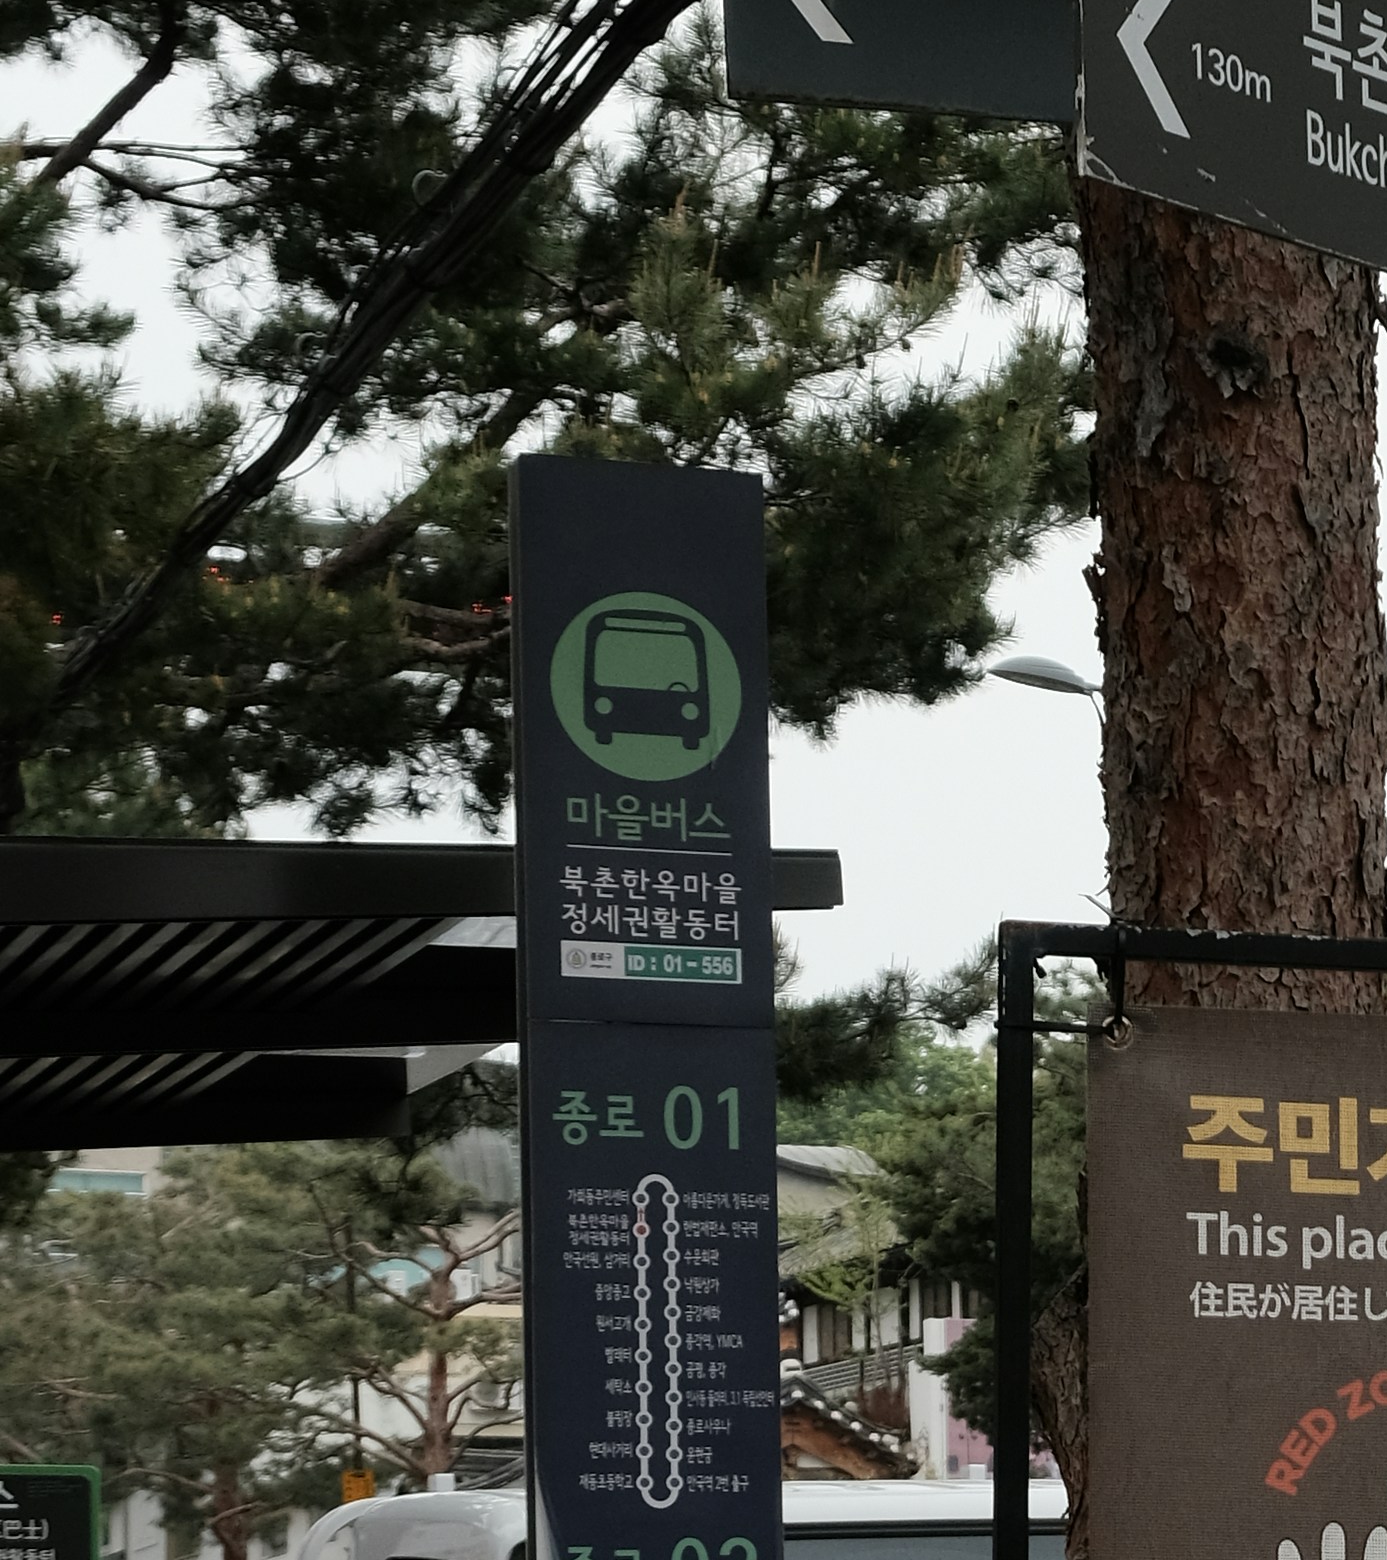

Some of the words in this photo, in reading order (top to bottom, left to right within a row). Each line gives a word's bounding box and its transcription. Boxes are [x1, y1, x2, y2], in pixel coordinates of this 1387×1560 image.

[1192, 43, 1271, 102] 130m
[567, 793, 731, 842] 마을버스
[560, 866, 741, 904] 북촌한옥마을
[562, 903, 738, 940] 정세권활동터
[628, 954, 645, 970] ID
[553, 1091, 644, 1145] 종로
[664, 1086, 739, 1149] 01
[1187, 1211, 1287, 1257] This
[1266, 1409, 1335, 1495] RED
